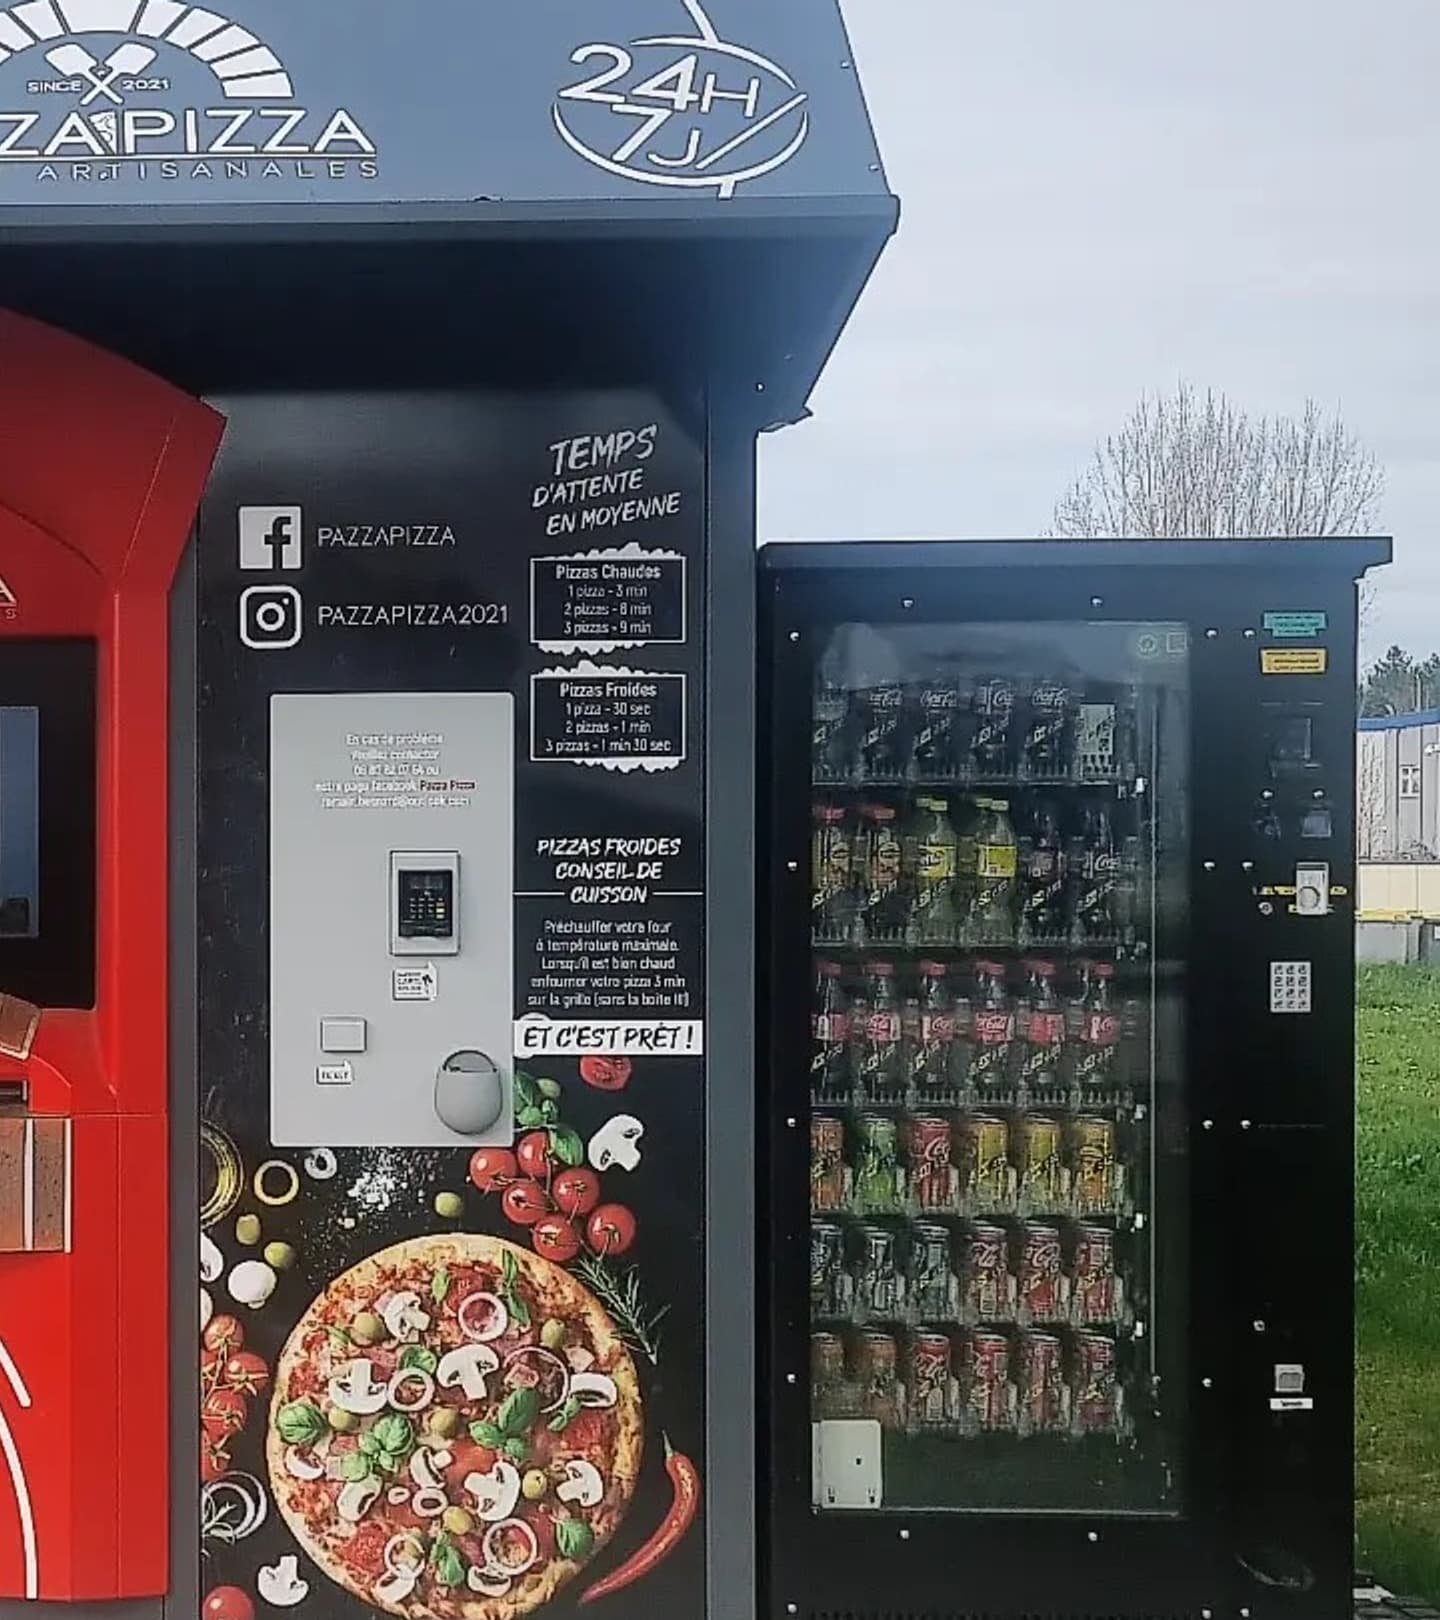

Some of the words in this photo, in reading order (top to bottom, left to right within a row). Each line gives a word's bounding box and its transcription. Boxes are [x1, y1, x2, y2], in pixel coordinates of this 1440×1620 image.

[27, 80, 82, 93] SINCE
[122, 79, 170, 92] 2021
[37, 161, 379, 182] ARTISANALES
[549, 423, 658, 476] TEMPS
[532, 467, 644, 508] D'ATTENTE
[546, 512, 577, 536] EN
[580, 492, 681, 531] MOYENNE
[317, 525, 457, 547] PAZZAPIZZA
[555, 563, 599, 580] Pizzas
[601, 563, 662, 580] Chaudes
[568, 584, 574, 598] 1
[575, 584, 606, 600] pizza
[615, 584, 624, 598] 3
[625, 584, 648, 598] min
[317, 604, 509, 626] PAZZAPIZZA2021
[563, 602, 572, 616] 2
[573, 602, 610, 618] pizzas
[629, 602, 652, 616] min
[563, 621, 572, 635] 3
[573, 620, 610, 637] pizzas
[619, 621, 628, 635] 9
[629, 620, 652, 635] min
[559, 682, 604, 698] Pizzas
[605, 682, 658, 698] Froides
[566, 702, 572, 716] 1
[574, 702, 602, 718] pizza
[612, 702, 628, 716] 30
[629, 704, 652, 716] sec
[565, 720, 573, 734] 2
[575, 720, 610, 736] pizzas
[621, 720, 626, 734] 1
[629, 720, 652, 734] min
[545, 738, 554, 752] 3
[555, 738, 590, 755] pizzas
[601, 738, 606, 752] 1
[609, 738, 632, 752] min
[649, 740, 672, 752] sec
[535, 838, 601, 857] PIZZAS
[603, 838, 682, 857] FROIDES
[555, 862, 635, 880] CONSEIL
[636, 862, 663, 880] DE
[570, 886, 648, 904] CUISSON
[614, 921, 646, 934] votre
[647, 920, 673, 934] four
[547, 938, 620, 953] température
[591, 957, 610, 970] est
[611, 956, 638, 970] bien
[639, 956, 676, 970] chaud
[590, 975, 622, 988] votre
[623, 974, 652, 990] pizza
[653, 974, 662, 988] 3
[663, 974, 686, 988] min
[527, 994, 547, 1006] sur
[549, 992, 561, 1006] la
[562, 992, 592, 1009] grille
[627, 992, 639, 1006] la
[523, 1025, 553, 1049] ET
[555, 1025, 621, 1049] C'EST
[622, 1022, 682, 1051] PRÊT
[685, 1025, 694, 1049] !
